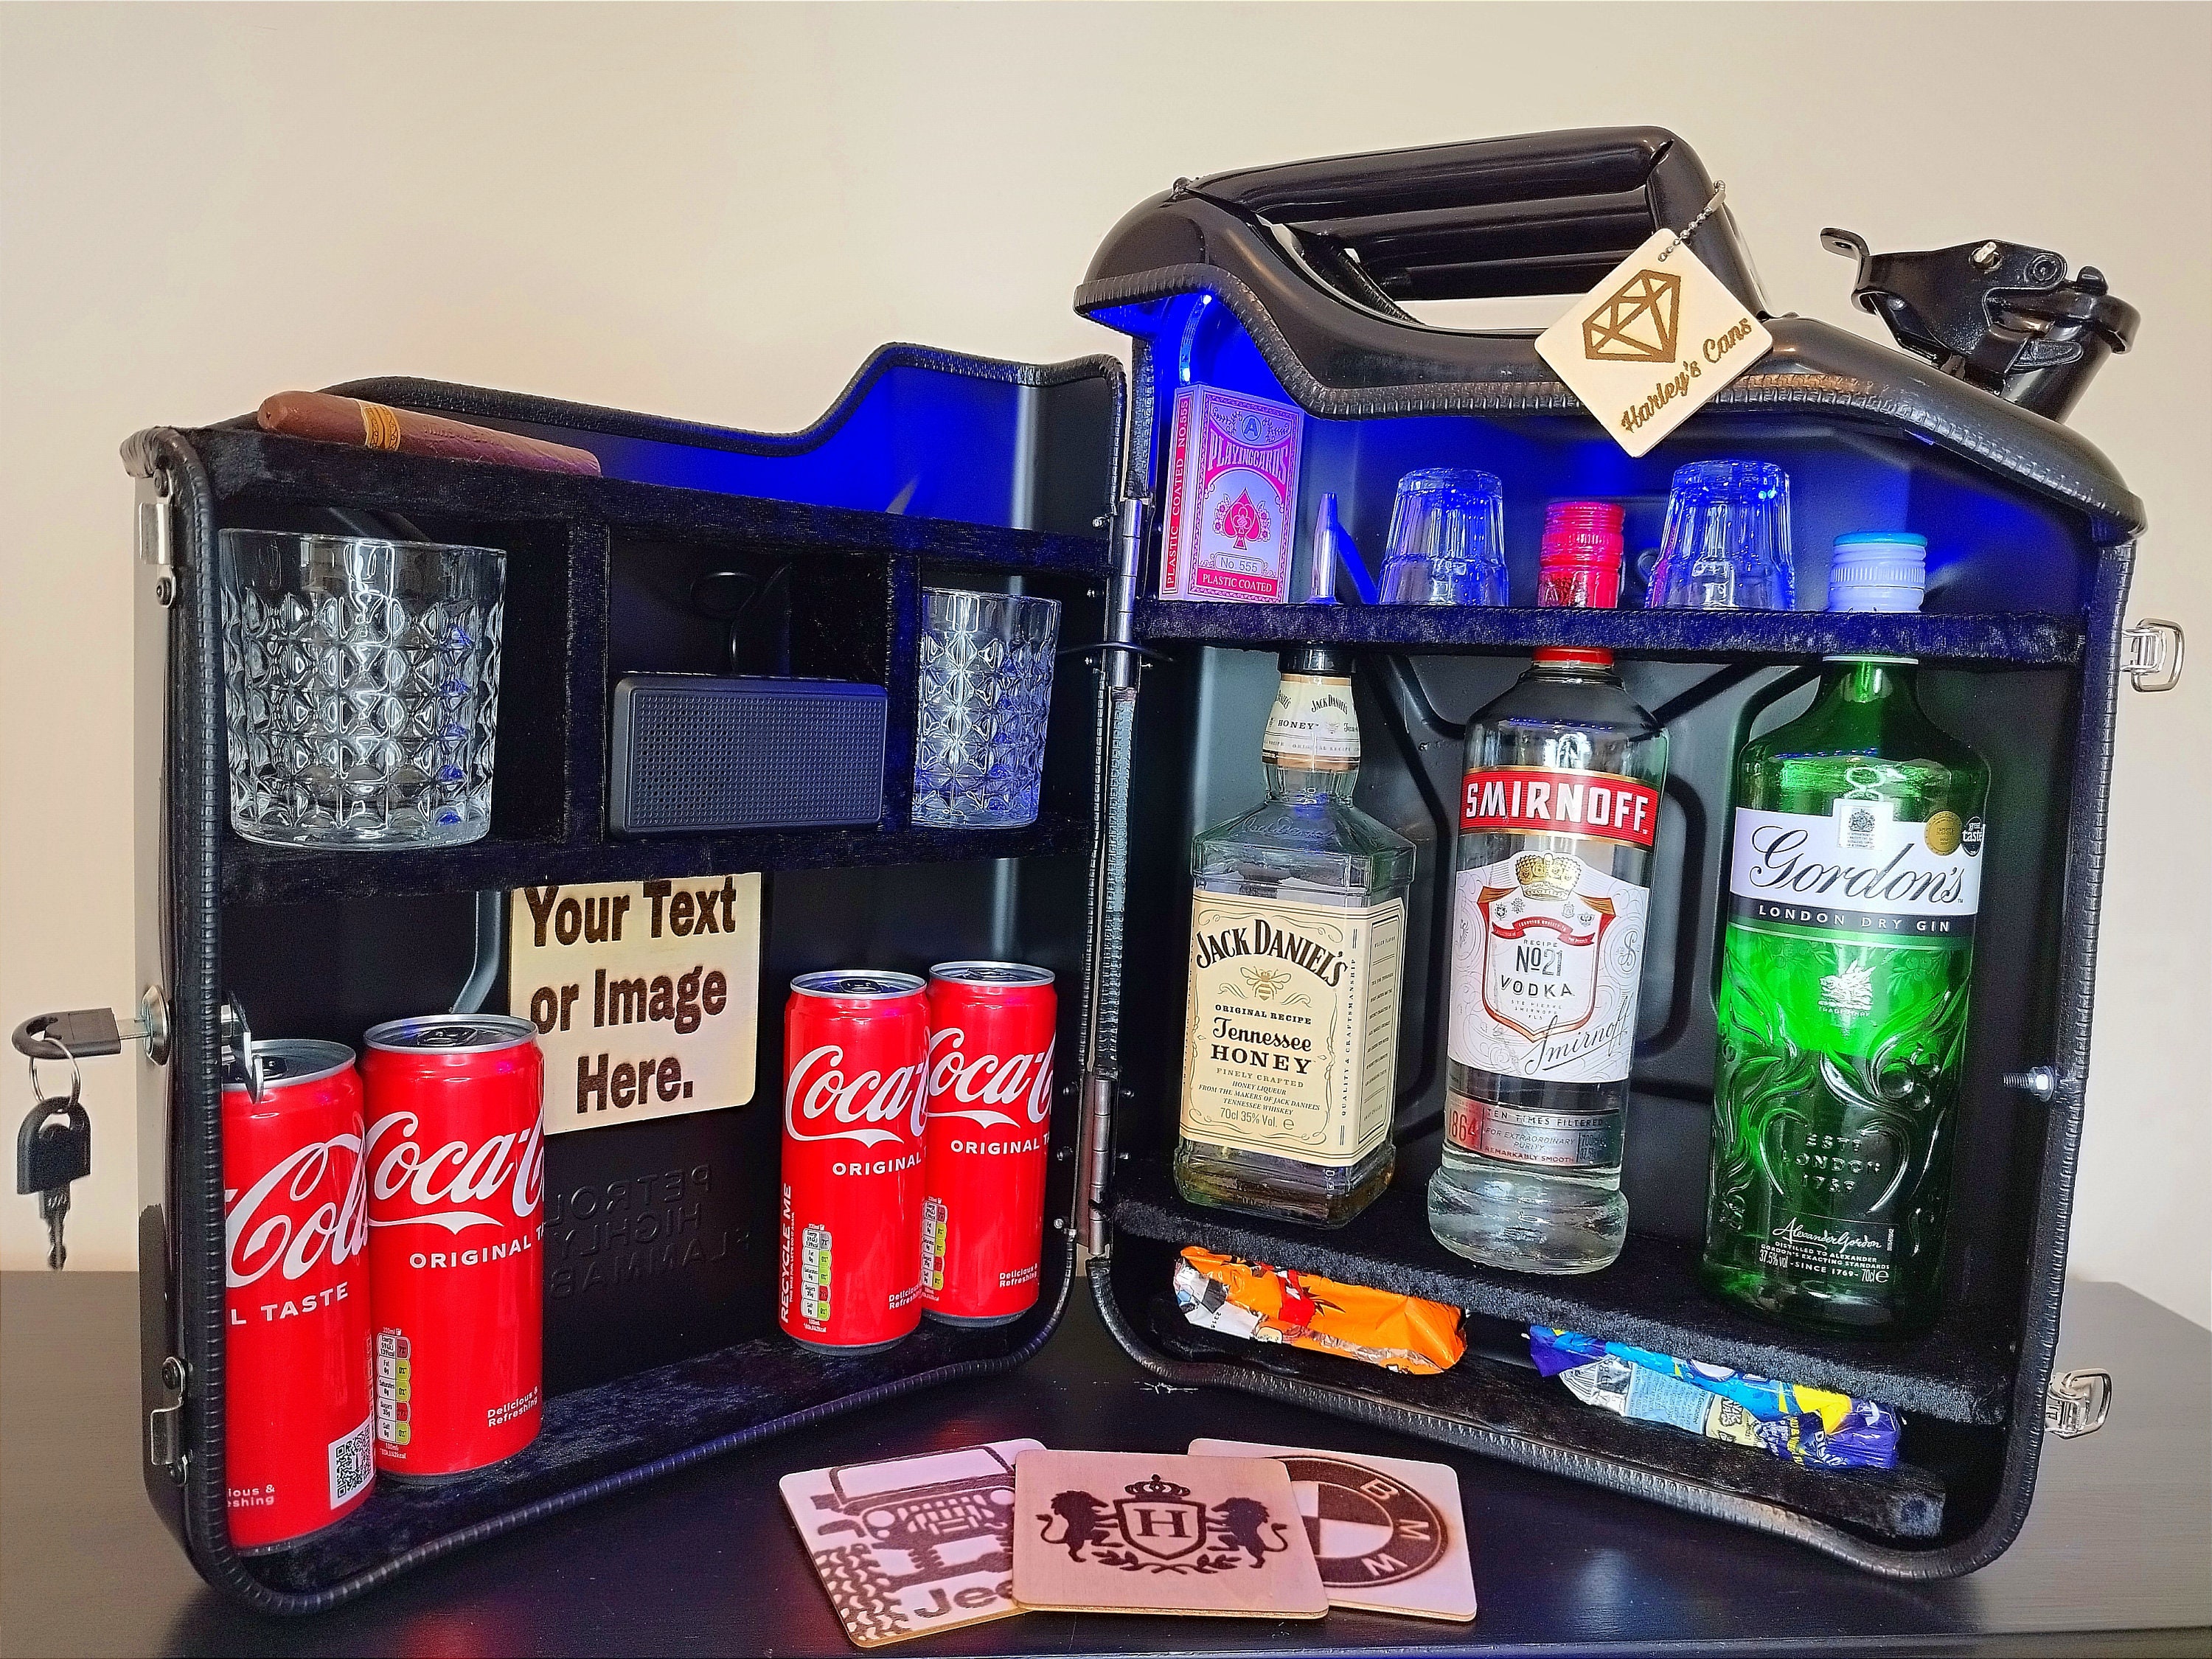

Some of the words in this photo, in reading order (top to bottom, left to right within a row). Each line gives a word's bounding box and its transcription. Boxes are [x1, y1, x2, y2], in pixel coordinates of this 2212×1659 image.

[1621, 360, 1703, 434] Harley's
[1703, 317, 1753, 364] Cans
[1178, 400, 1189, 448] NO.555
[1172, 457, 1185, 517] COATED
[1166, 525, 1180, 585] PLASTIC
[1239, 560, 1258, 573] 555
[1202, 572, 1237, 588] PLASTIC
[1238, 579, 1273, 594] COATED
[1311, 698, 1327, 713] JACK
[1277, 719, 1315, 731] HONEY
[1465, 780, 1649, 832] SMIRNOFF
[1749, 825, 1966, 905] Gordon's
[524, 885, 630, 947] Your
[642, 876, 737, 939] Text
[1759, 905, 1846, 926] LONDON
[1861, 916, 1903, 931] DRY
[1916, 920, 1950, 933] GIN
[1196, 926, 1251, 970] JACK
[1254, 919, 1349, 987] DANIEL'S
[1523, 939, 1558, 948] RECIPE
[530, 983, 580, 1035] or
[594, 965, 728, 1034] Image
[1500, 974, 1576, 998] VODKA
[1214, 1004, 1267, 1019] ORIGINAL
[1270, 1012, 1312, 1026] RECIPE
[1212, 1017, 1312, 1052] Tennessee
[1341, 1068, 1349, 1116] QUALITY
[1346, 959, 1356, 1053] CRAFTSMANSHIP
[1524, 991, 1635, 1075] Smirnoff
[1210, 1044, 1313, 1075] HONEY
[577, 1053, 694, 1114] Here.
[1216, 1067, 1253, 1080] FINELY
[1256, 1074, 1304, 1089] CRAFTED
[1232, 1080, 1256, 1091] HONEY
[1256, 1085, 1287, 1096] LIQUEUR
[1198, 1084, 1218, 1093] FROM
[1218, 1087, 1234, 1096] THE
[1234, 1089, 1262, 1100] MAKERS
[1263, 1094, 1273, 1103] OF
[1273, 1095, 1290, 1106] JACK
[1222, 1097, 1262, 1110] TENNESSEE
[1262, 1105, 1294, 1116] WHISKEY
[1220, 1107, 1239, 1119] 70cl
[1240, 1110, 1260, 1124] 35%
[1262, 1113, 1278, 1128] Vol.
[1449, 1108, 1477, 1145] 1864
[1486, 1108, 1509, 1119] TEN
[1516, 1115, 1551, 1126] TIMES
[1557, 1118, 1604, 1127] FILTERED
[950, 1139, 1040, 1155] ORIGINAL
[1485, 1127, 1503, 1138] FOR
[1504, 1132, 1576, 1146] EXTRAORDINARY
[1513, 1141, 1545, 1151] PURITY
[832, 1151, 922, 1177] ORIGINAL
[1484, 1145, 1539, 1161] REMARKABLY
[783, 1182, 791, 1220] ME
[1772, 1217, 1838, 1246] Alexander
[1835, 1231, 1882, 1254] Gordon
[409, 1238, 532, 1269] ORIGINAL
[1761, 1244, 1799, 1258] GORDON'S
[1801, 1252, 1843, 1266] EXACTING
[1845, 1261, 1890, 1270] STANDARDS
[1775, 1241, 1815, 1255] DISTILLED
[1829, 1252, 1877, 1264] ALEXANDER
[781, 1222, 790, 1324] RECYCLE
[999, 1265, 1034, 1280] Delicious
[999, 1271, 1037, 1288] Refreshing
[260, 1281, 349, 1323] TASTE
[487, 1391, 533, 1419] Delicious
[488, 1396, 538, 1427] Refreshing
[265, 1484, 275, 1493] &
[1133, 1508, 1193, 1539] H
